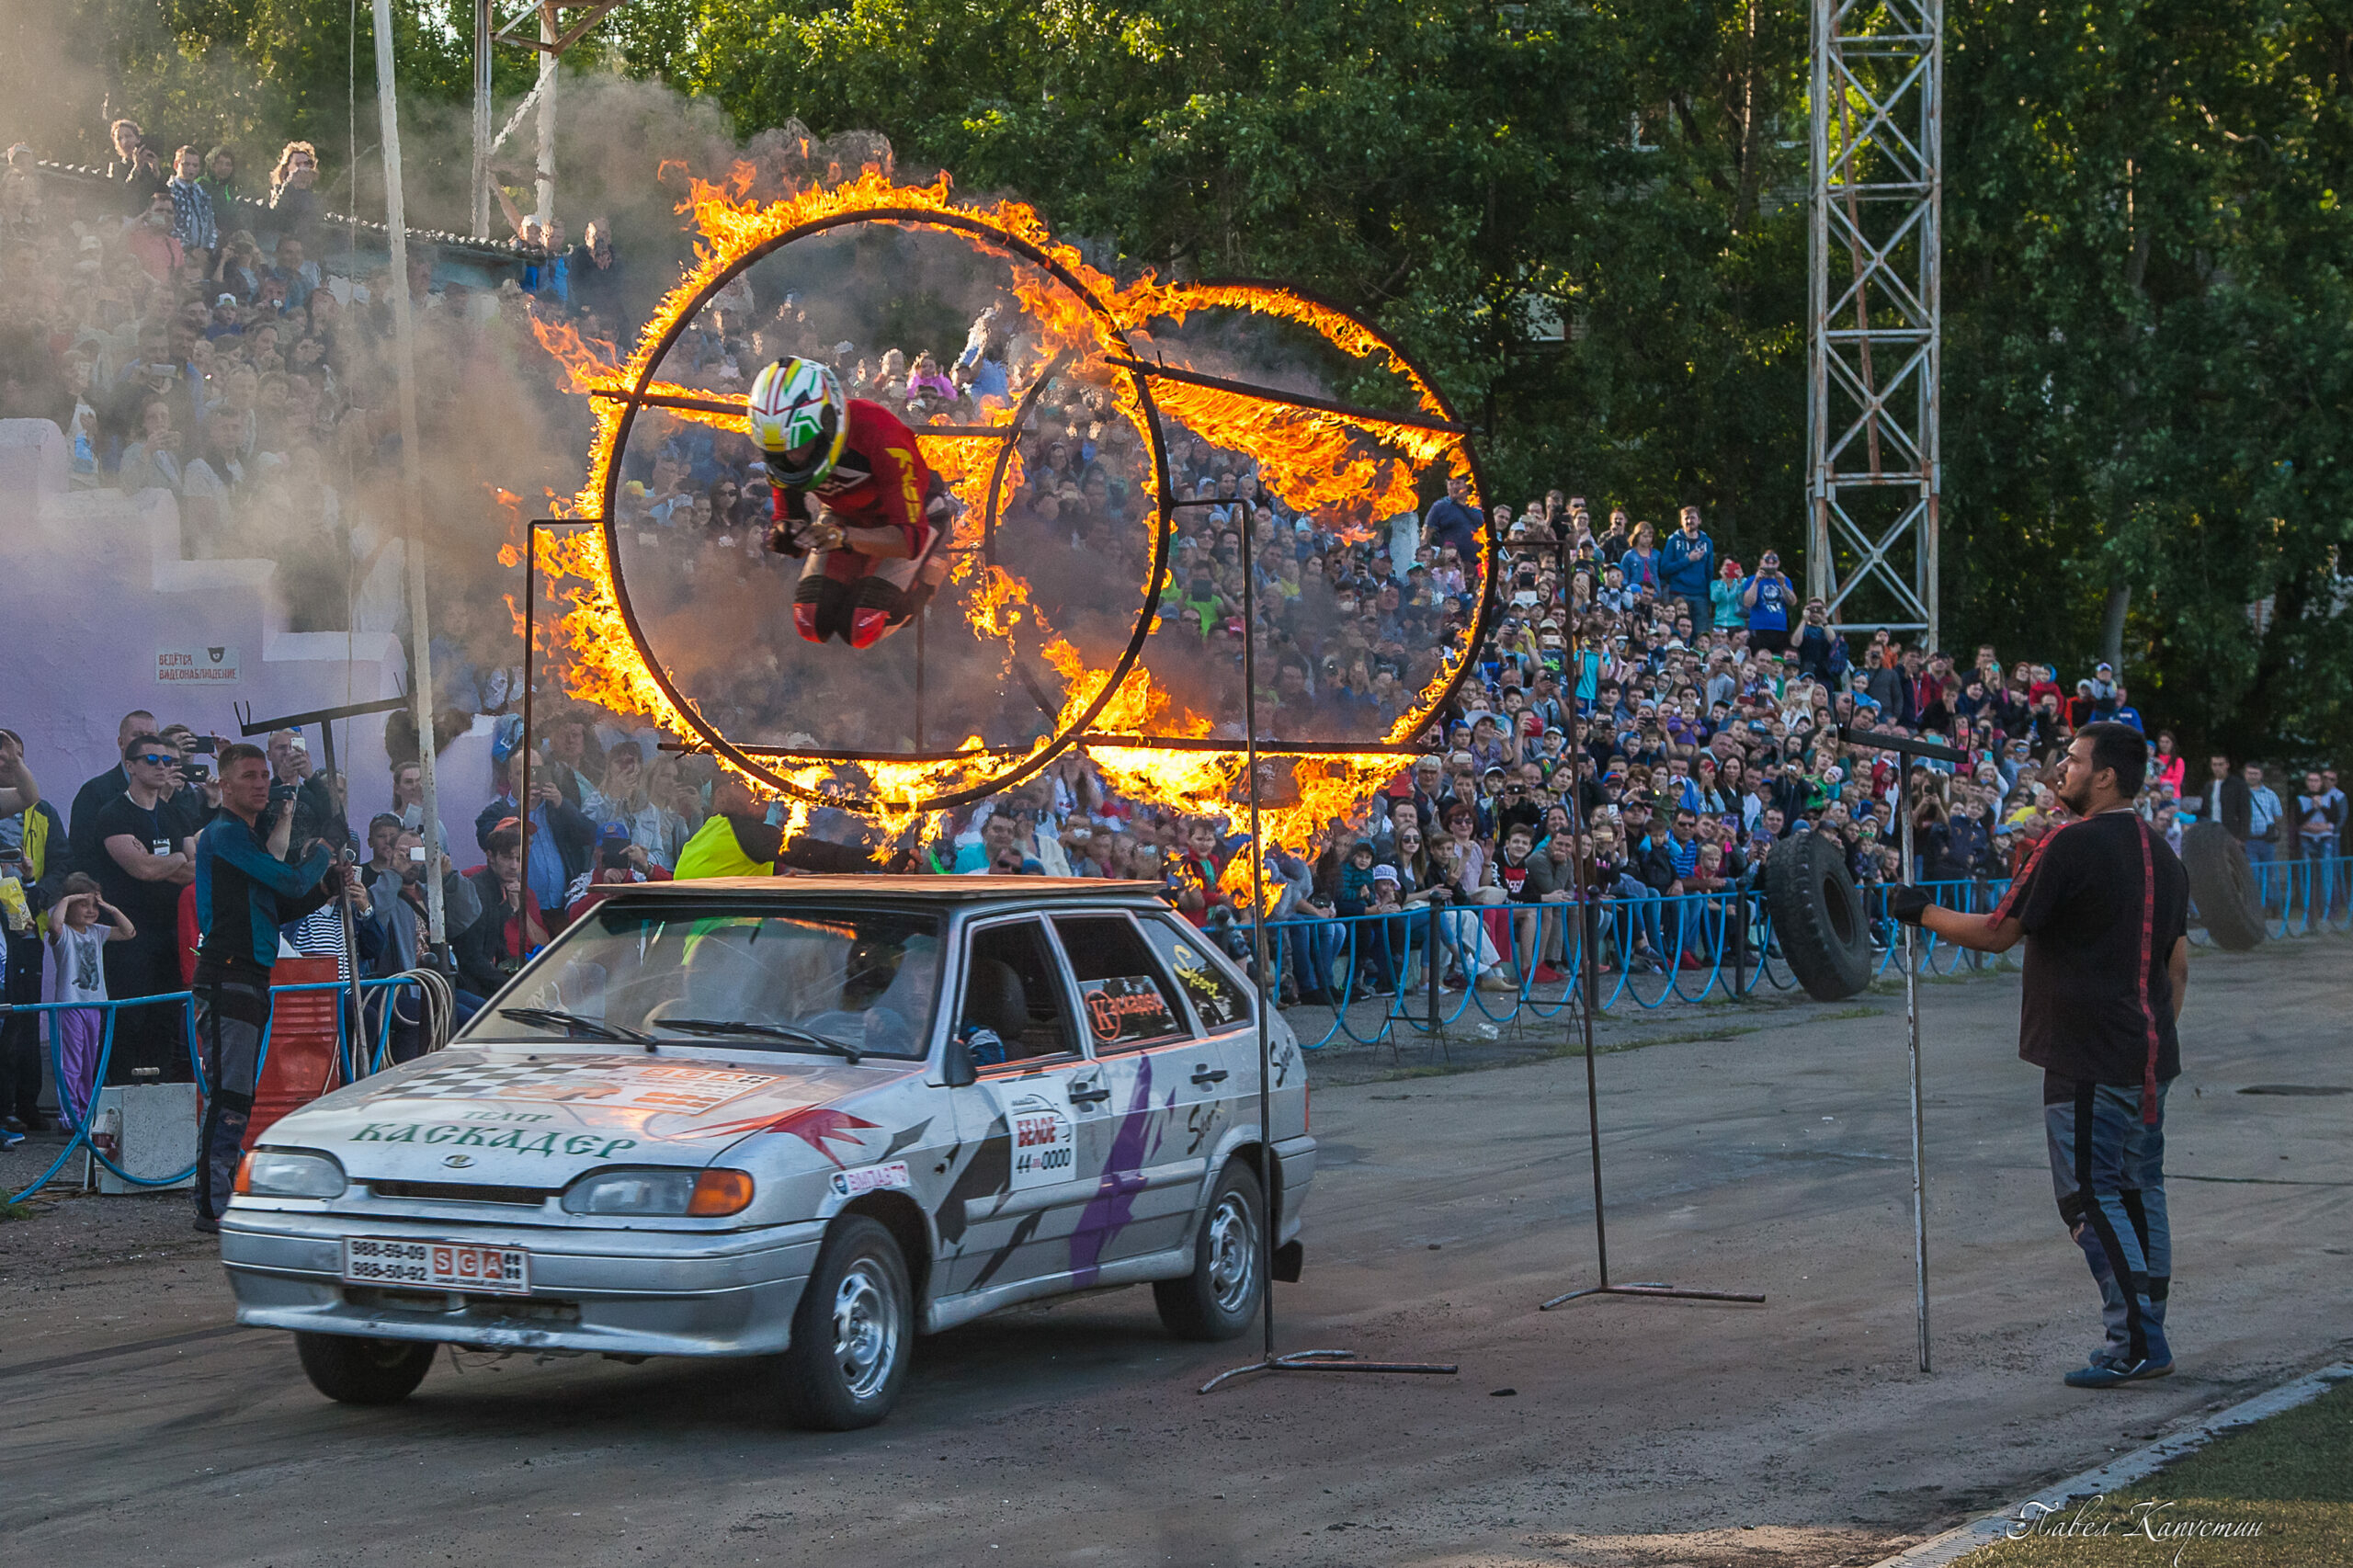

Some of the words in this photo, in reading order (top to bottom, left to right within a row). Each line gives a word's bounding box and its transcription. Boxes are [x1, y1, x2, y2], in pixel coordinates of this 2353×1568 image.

[158, 652, 193, 666] ВЕДЁТСЯ
[158, 668, 236, 680] ВИДЕОНАБЛЮДЕНИЕ
[461, 1110, 553, 1123] ТЕАТР
[434, 1250, 503, 1276] SGA
